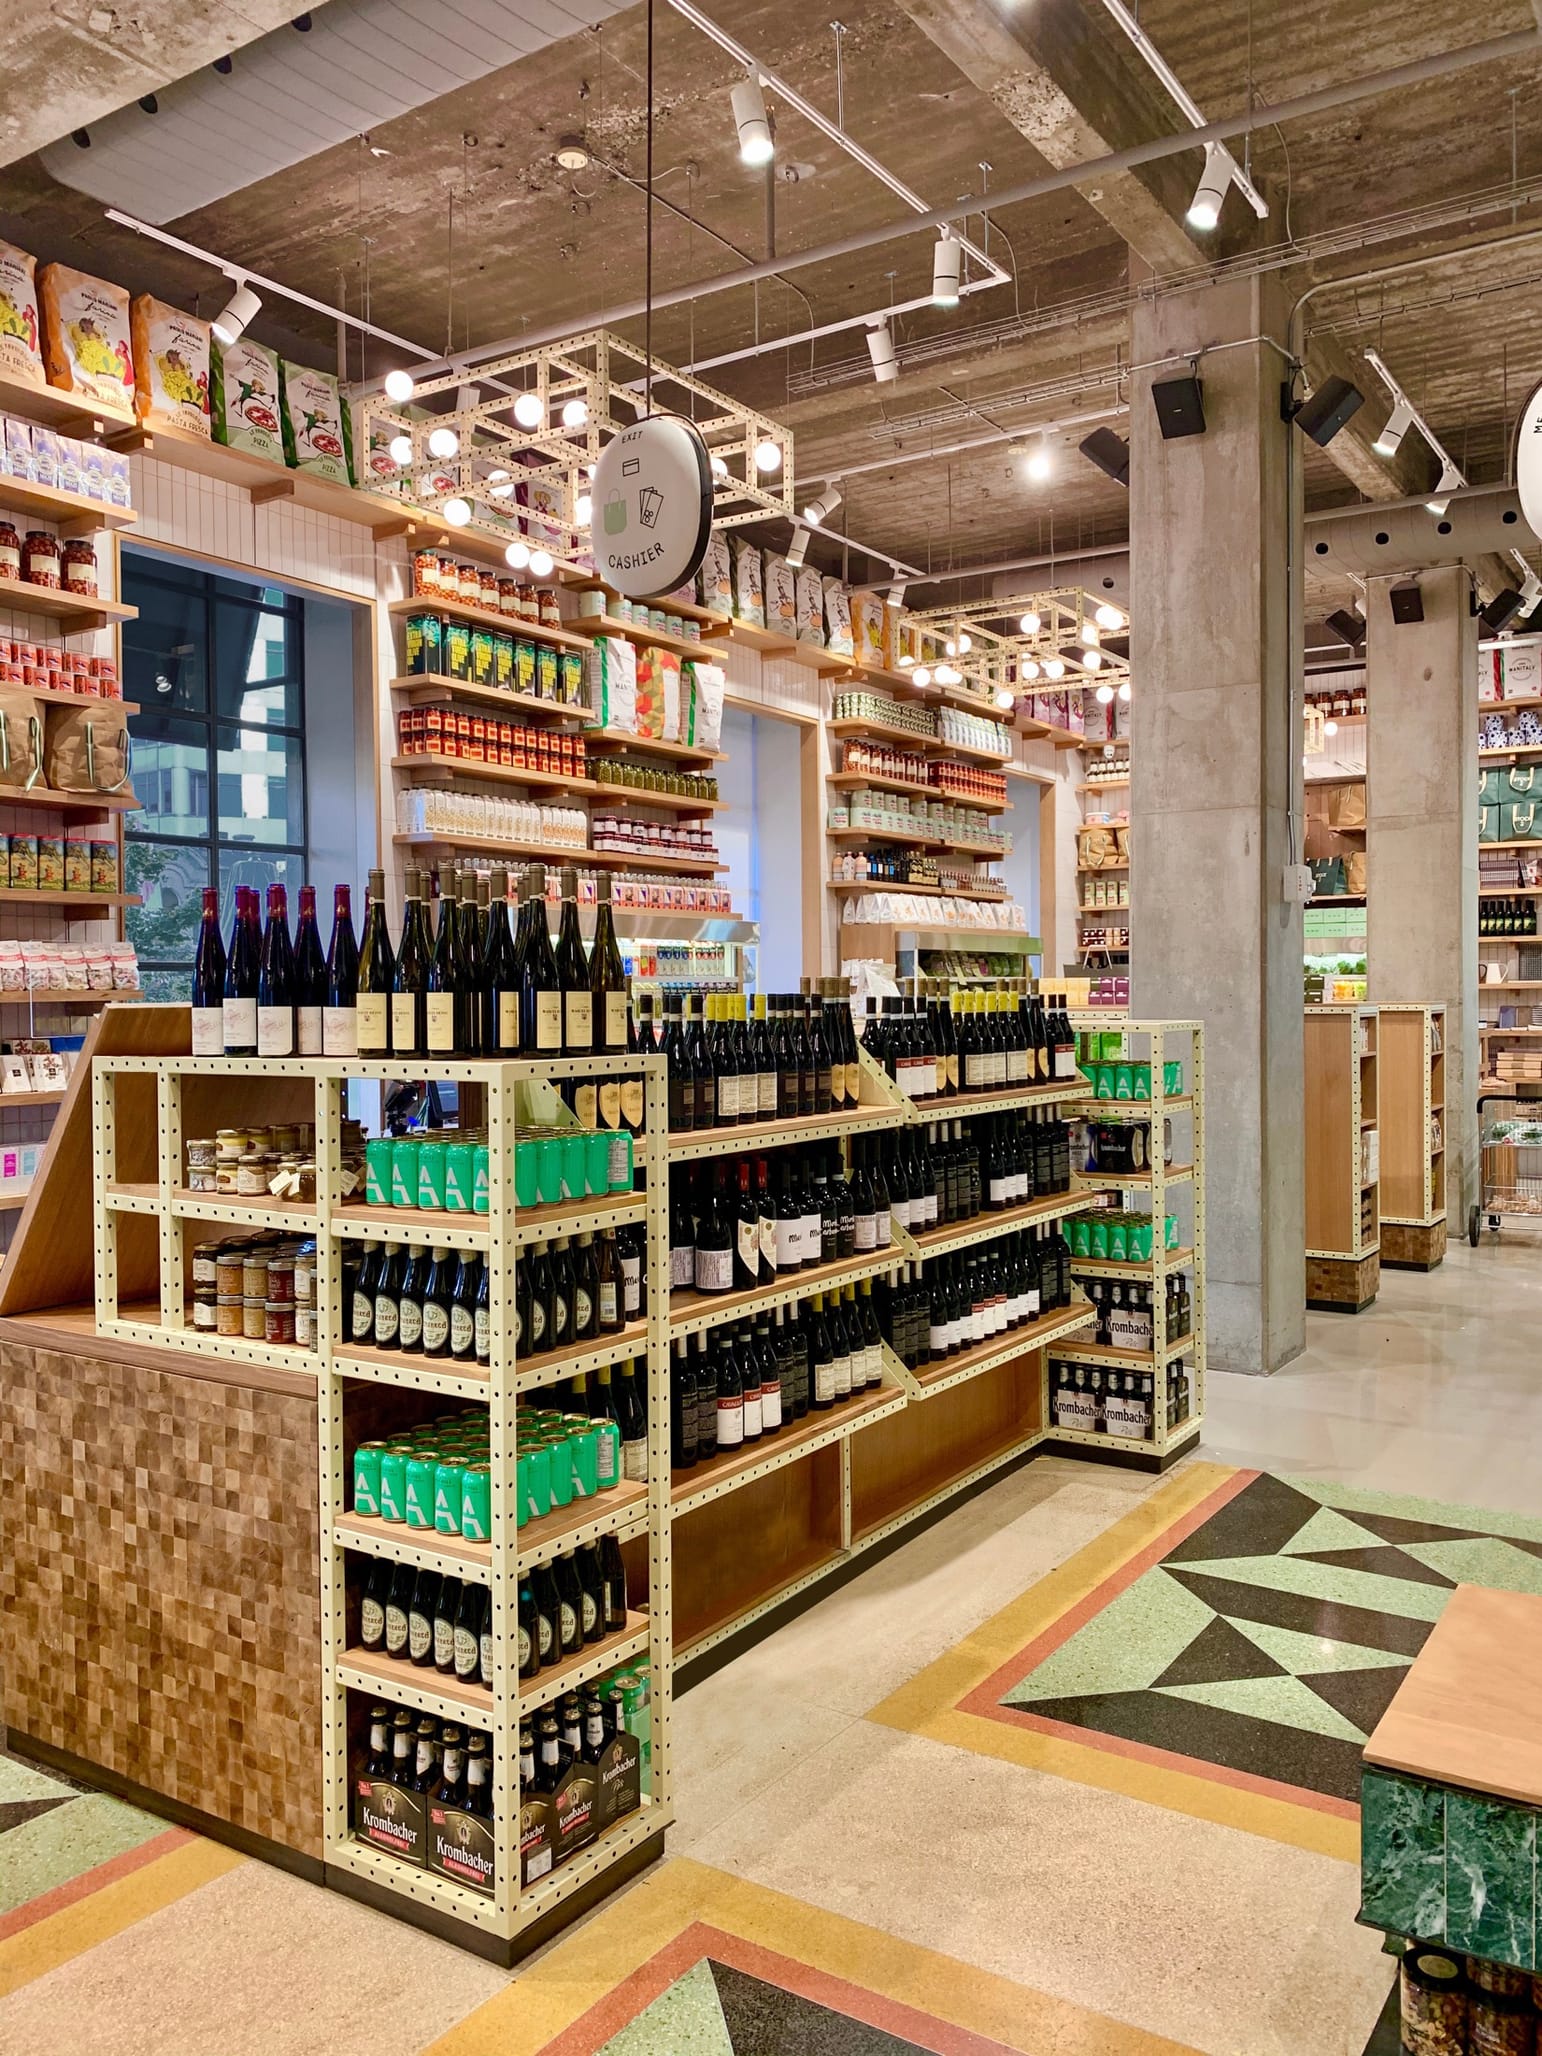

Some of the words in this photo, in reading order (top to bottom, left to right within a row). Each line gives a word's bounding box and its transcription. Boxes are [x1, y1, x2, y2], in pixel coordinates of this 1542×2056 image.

[253, 436, 269, 449] PIZZA
[621, 430, 644, 444] EXIT
[608, 542, 665, 570] CASHIER
[1106, 1316, 1154, 1336] Krombache
[1053, 1397, 1100, 1418] Krombacher
[1102, 1403, 1152, 1425] Krombacher
[602, 1755, 637, 1785] Krombacher
[363, 1806, 418, 1844] Krombacher
[559, 1800, 593, 1829] Krombacher
[436, 1835, 494, 1876] Krombacher
